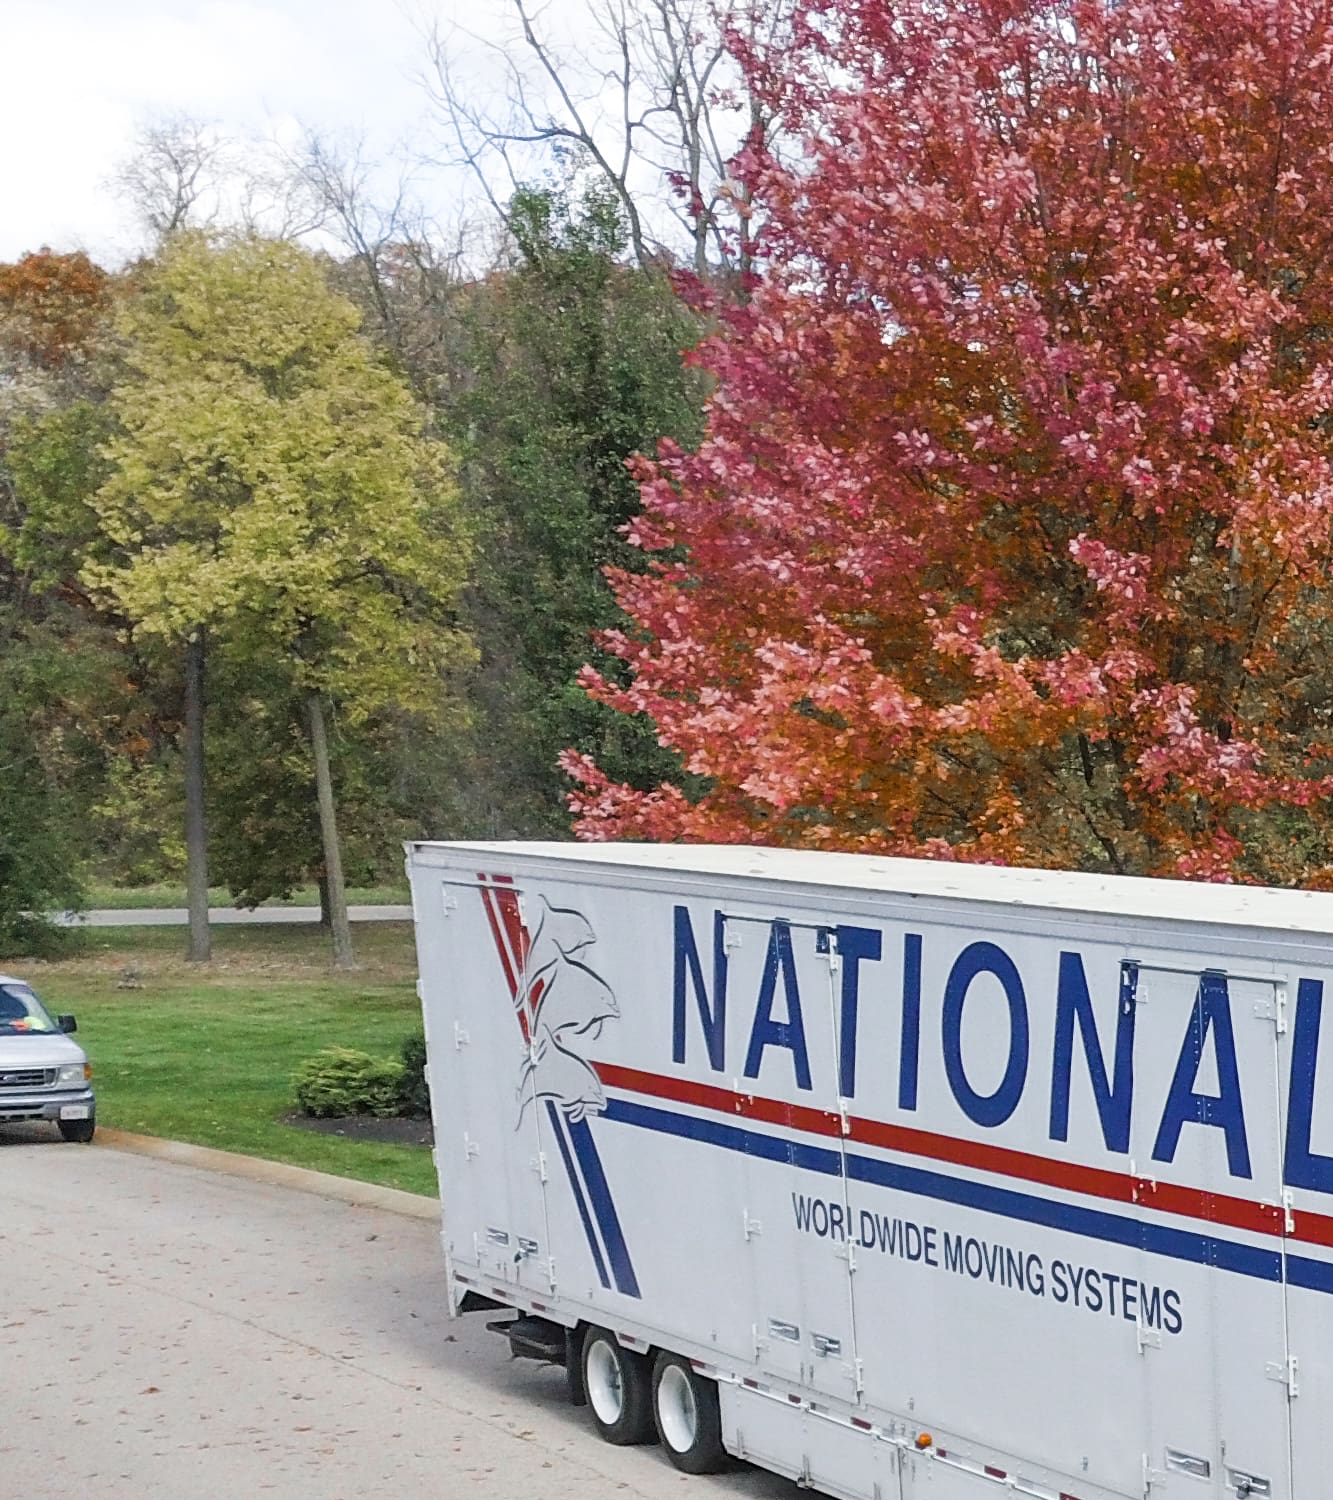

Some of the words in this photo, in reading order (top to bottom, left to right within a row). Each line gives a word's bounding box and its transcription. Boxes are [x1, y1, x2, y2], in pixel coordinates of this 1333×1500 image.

[792, 1192, 939, 1268] WORLDWIDE
[943, 1231, 1045, 1298] MOVING
[1051, 1259, 1183, 1335] SYSTEMS
